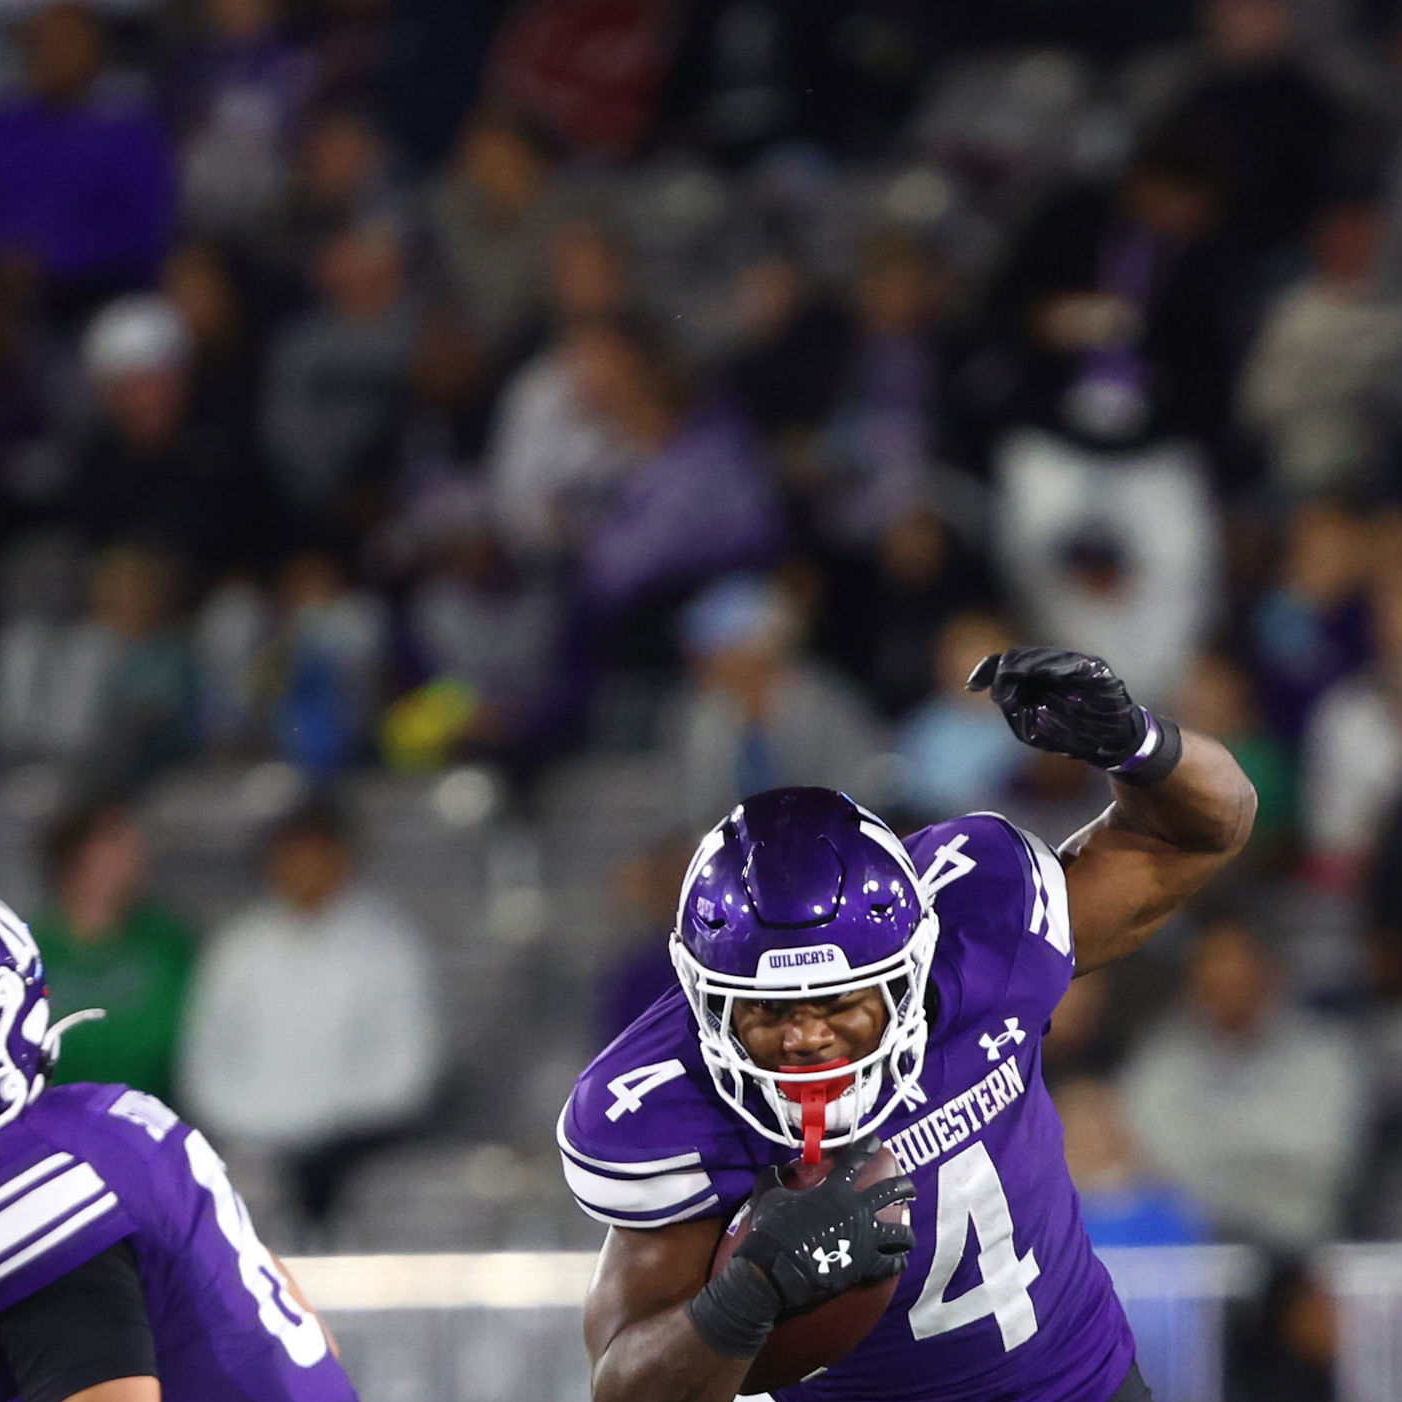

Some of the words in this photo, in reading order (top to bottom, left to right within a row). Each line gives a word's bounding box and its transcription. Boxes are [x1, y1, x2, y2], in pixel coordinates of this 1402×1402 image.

[917, 832, 977, 905] 4
[769, 949, 835, 969] WILDCATS
[605, 1058, 686, 1123] 4
[882, 1054, 1025, 1175] HWESTERN
[909, 1140, 1040, 1352] 4
